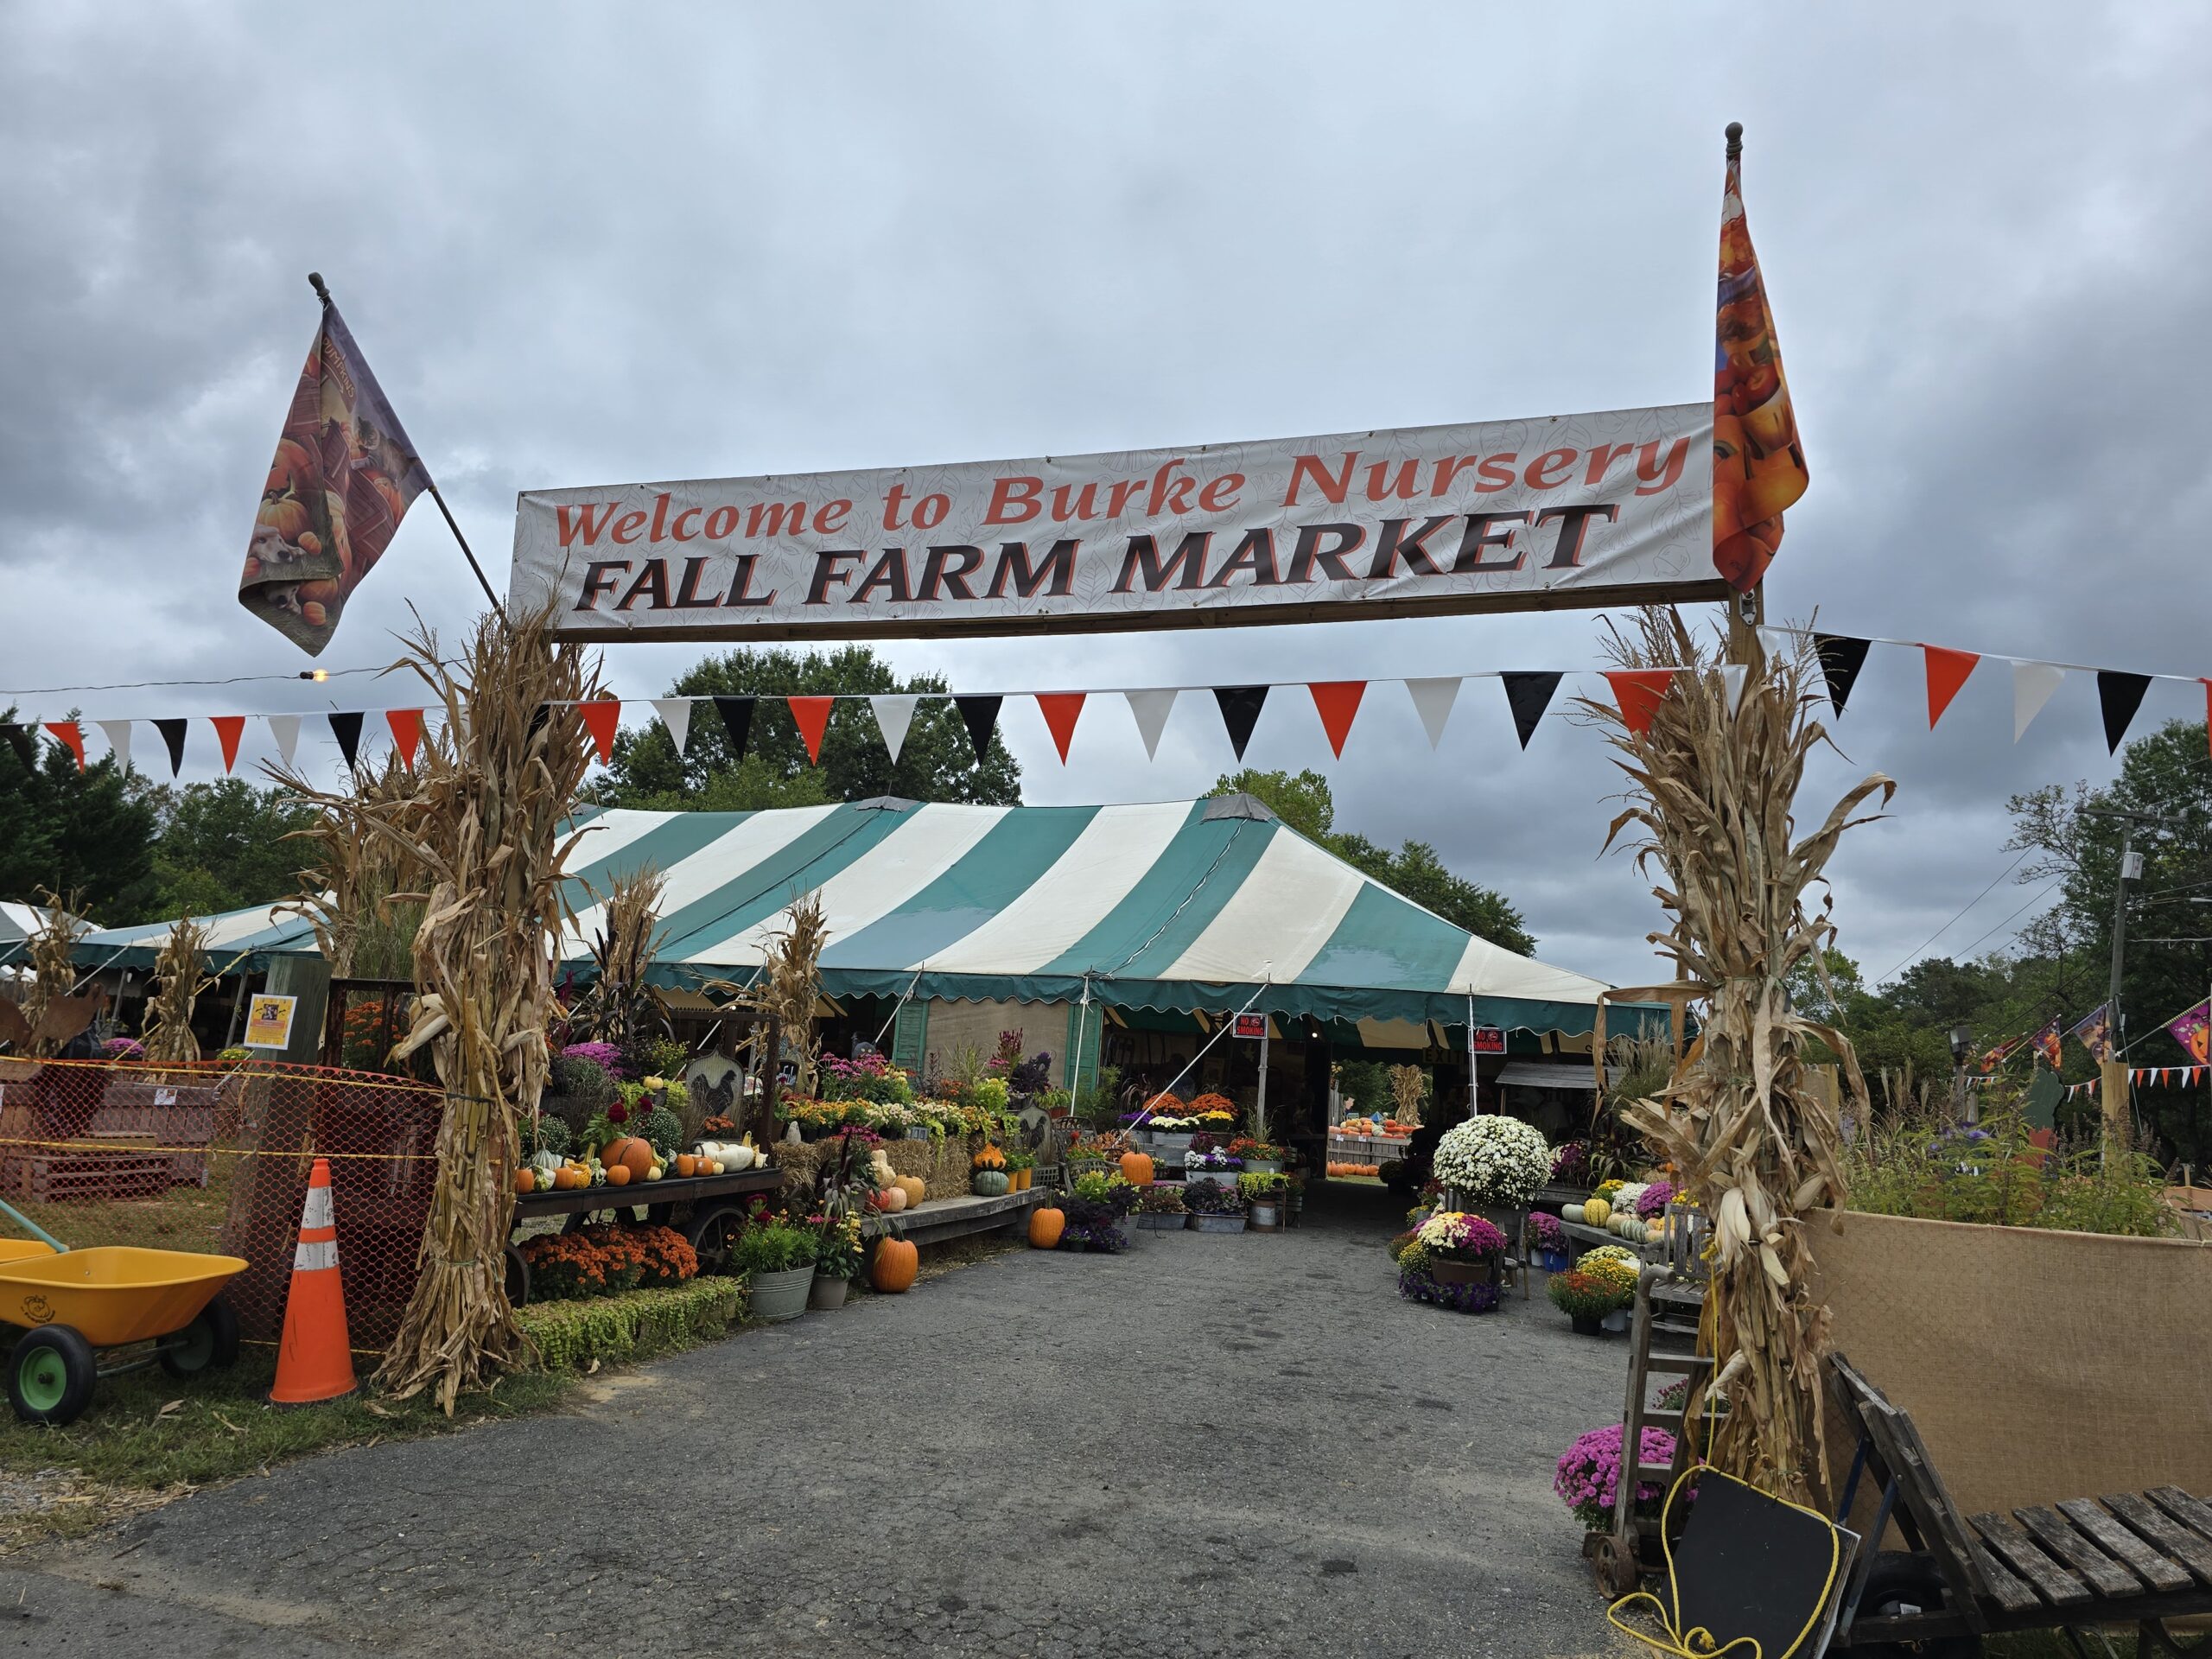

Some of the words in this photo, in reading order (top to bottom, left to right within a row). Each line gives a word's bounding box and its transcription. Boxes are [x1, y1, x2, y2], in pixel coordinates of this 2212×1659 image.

[322, 337, 355, 397] PUMPKINS
[555, 492, 853, 547] Welcome
[881, 482, 951, 531] to
[980, 456, 1248, 525] Burke
[1279, 435, 1691, 507] Nursery
[572, 553, 779, 612] FALL
[804, 537, 1084, 605] FARM
[1106, 504, 1621, 594] MARKET
[1240, 1016, 1249, 1026] NO
[1236, 1026, 1263, 1036] SMOKING
[1476, 1031, 1485, 1040] NO
[1472, 1041, 1503, 1052] SMOKING
[1426, 1048, 1461, 1063] EXIT
